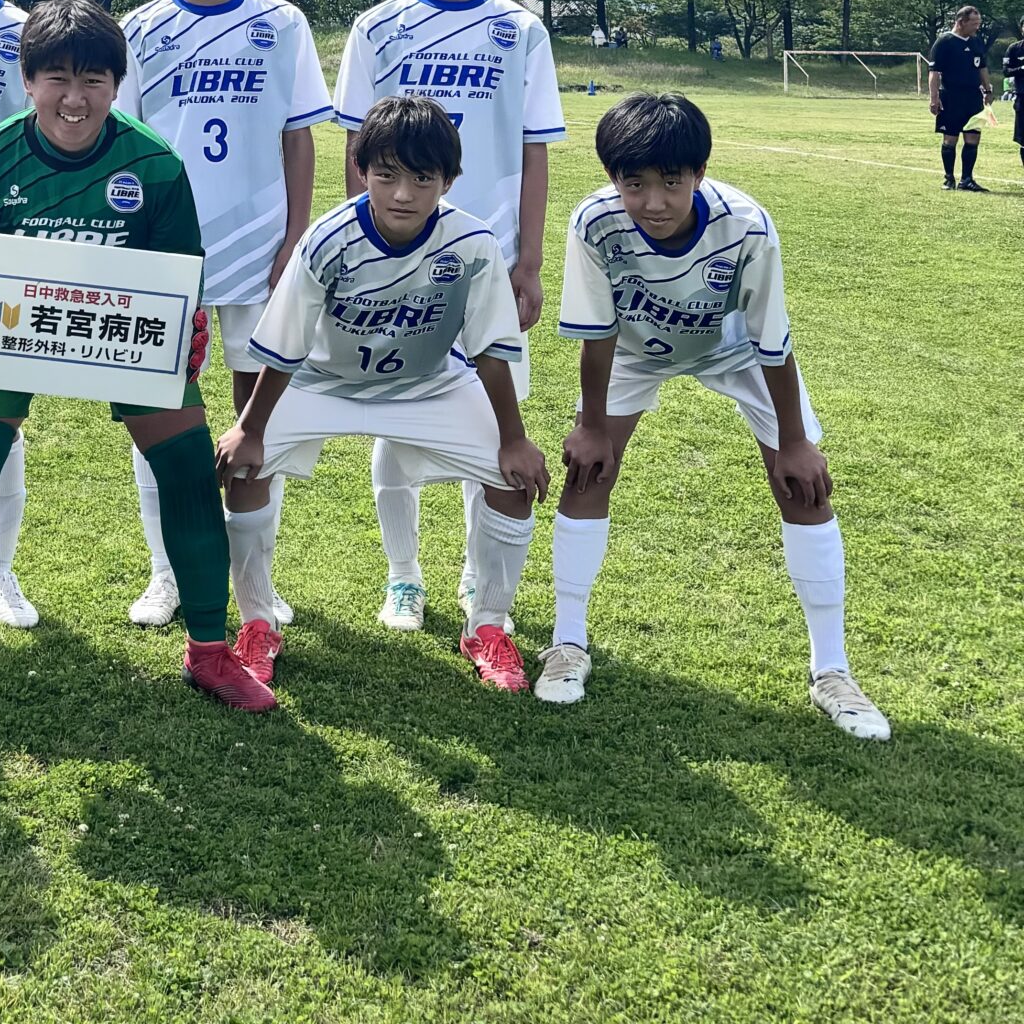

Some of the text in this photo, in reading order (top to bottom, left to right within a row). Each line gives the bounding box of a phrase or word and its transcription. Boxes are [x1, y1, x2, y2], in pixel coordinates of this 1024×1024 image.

[235, 58, 264, 66] CLUB
[409, 52, 503, 64] FOOTBALL CLUB
[171, 69, 268, 97] LIBRE
[399, 64, 505, 89] LIBRE
[230, 95, 258, 104] 2016
[467, 91, 493, 100] 201
[203, 118, 228, 163] 3
[111, 189, 140, 198] LIBRE
[21, 217, 126, 229] FOOTBALL CLUB
[707, 273, 734, 281] LIBR
[24, 284, 133, 309] 日中救急受入可
[613, 289, 725, 328] LIBRE
[687, 301, 724, 310] CLUB
[30, 304, 167, 347] 若宮病院
[331, 303, 447, 328] LIBRE
[404, 326, 435, 336] 2016
[1, 335, 143, 364] 整形外科・リハビリ
[358, 346, 404, 373] 16
[643, 337, 674, 362] 2
